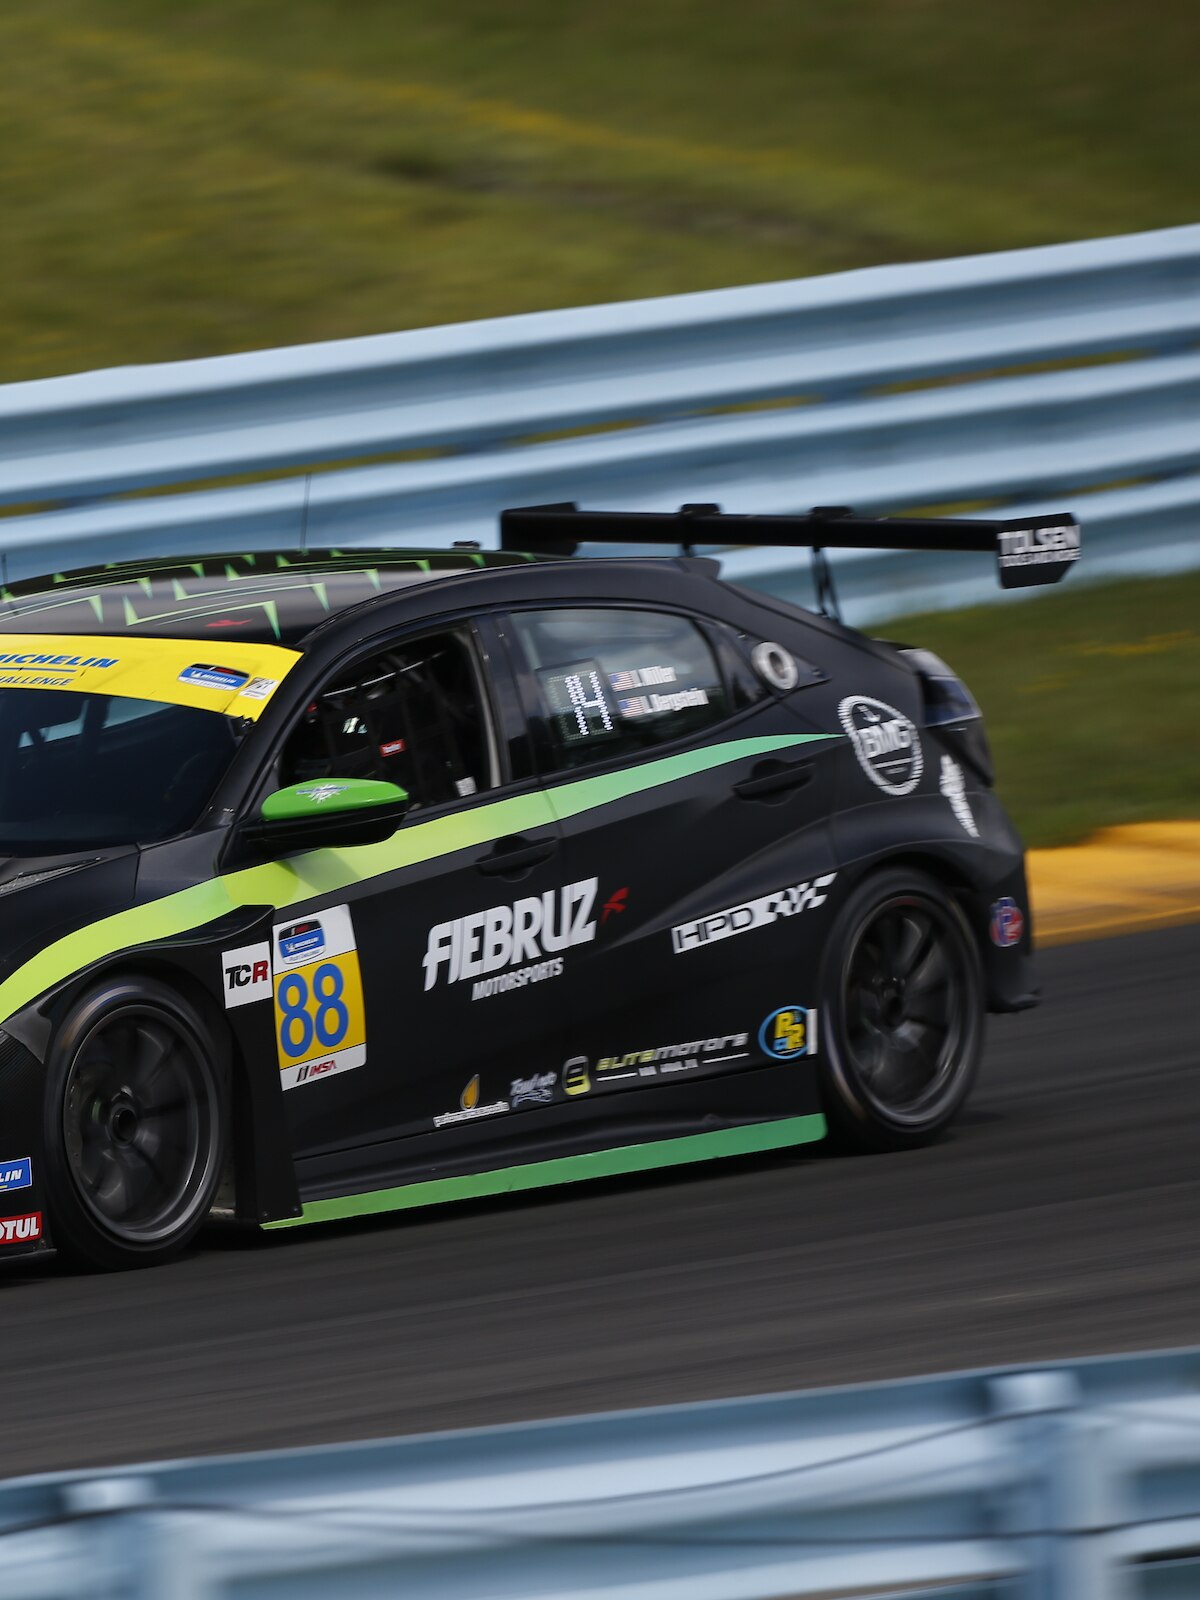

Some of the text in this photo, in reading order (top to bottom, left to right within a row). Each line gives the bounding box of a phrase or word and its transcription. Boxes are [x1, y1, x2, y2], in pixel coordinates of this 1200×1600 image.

[997, 525, 1080, 555] TOLSEN
[422, 876, 599, 991] FIEBRUZ
[676, 907, 754, 949] HPD
[225, 960, 268, 989] TCR
[471, 957, 564, 1001] MOTORSPORTS
[278, 963, 349, 1058] 88
